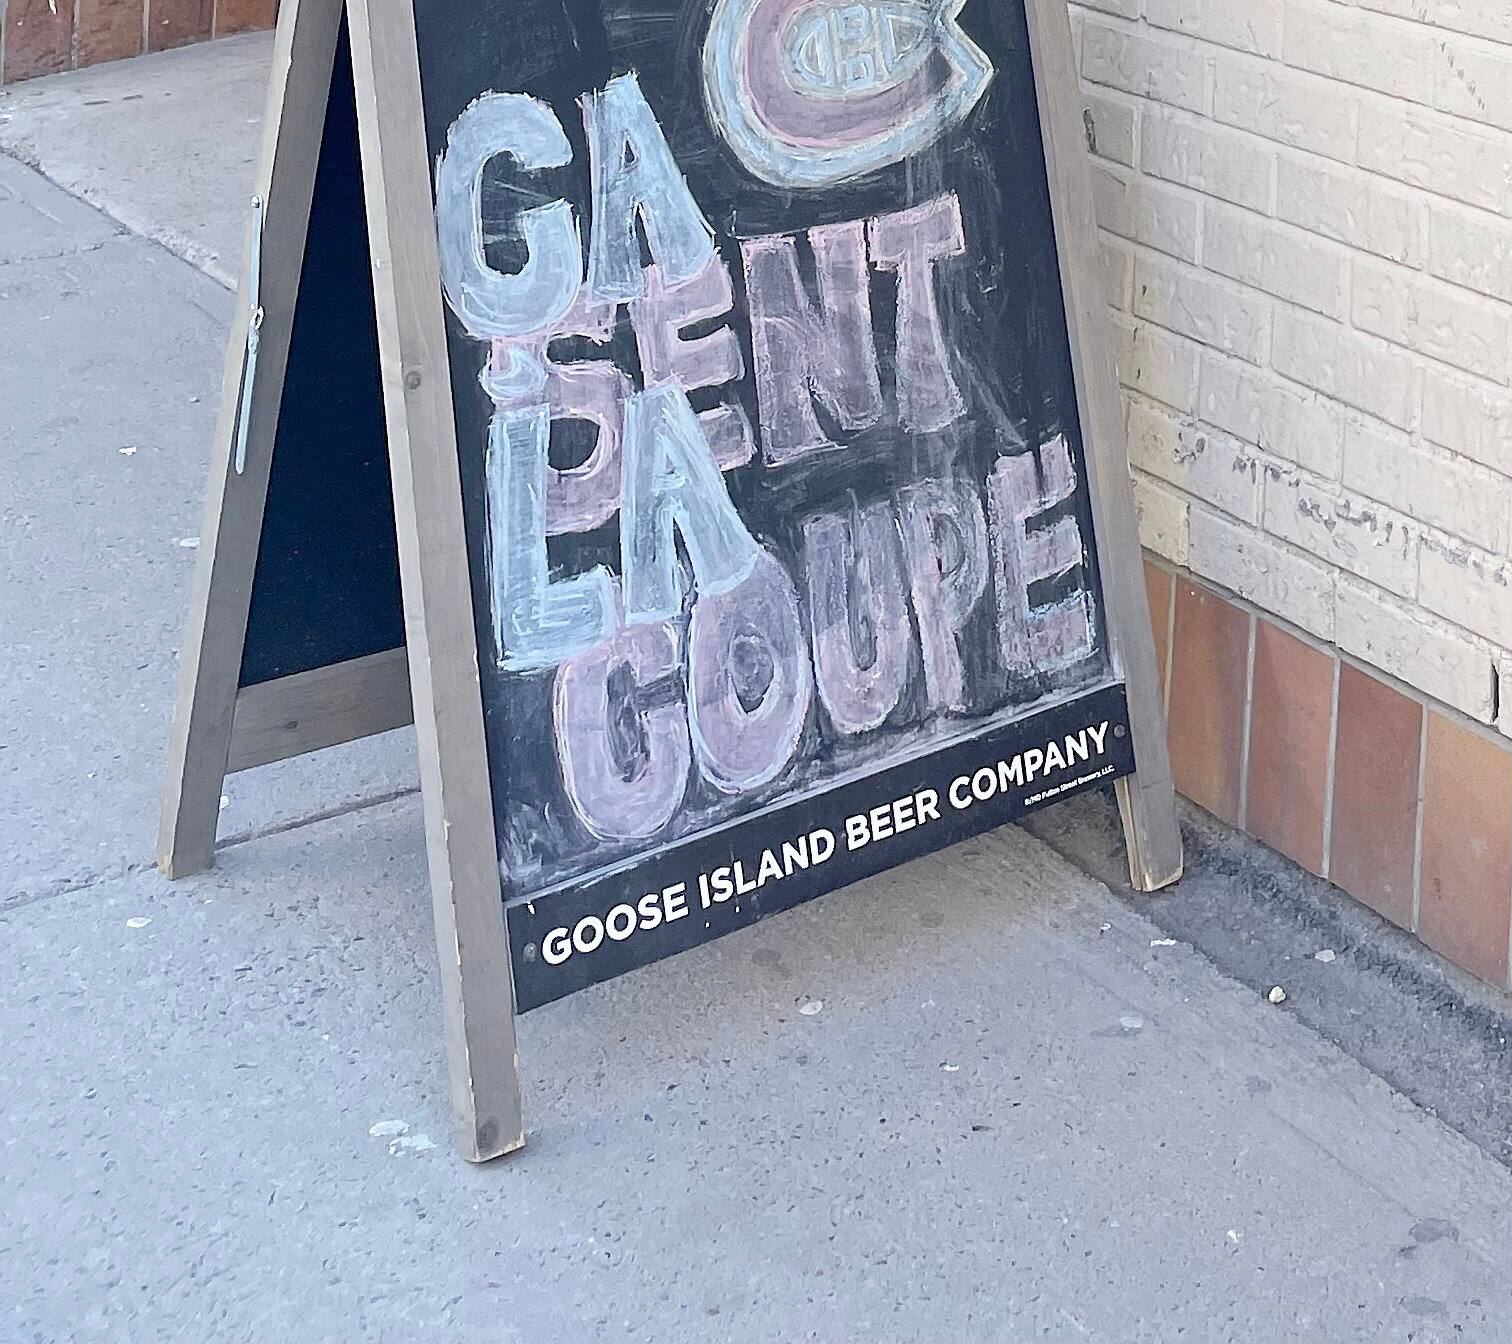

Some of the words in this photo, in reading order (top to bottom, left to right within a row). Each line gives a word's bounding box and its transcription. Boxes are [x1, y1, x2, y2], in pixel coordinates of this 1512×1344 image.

[484, 384, 762, 674] LA
[553, 427, 1098, 842] COUPE
[541, 883, 689, 966] GOOSE
[698, 829, 835, 909] ISLAND
[846, 789, 941, 851] BEER
[949, 720, 1109, 809] COMPANY
